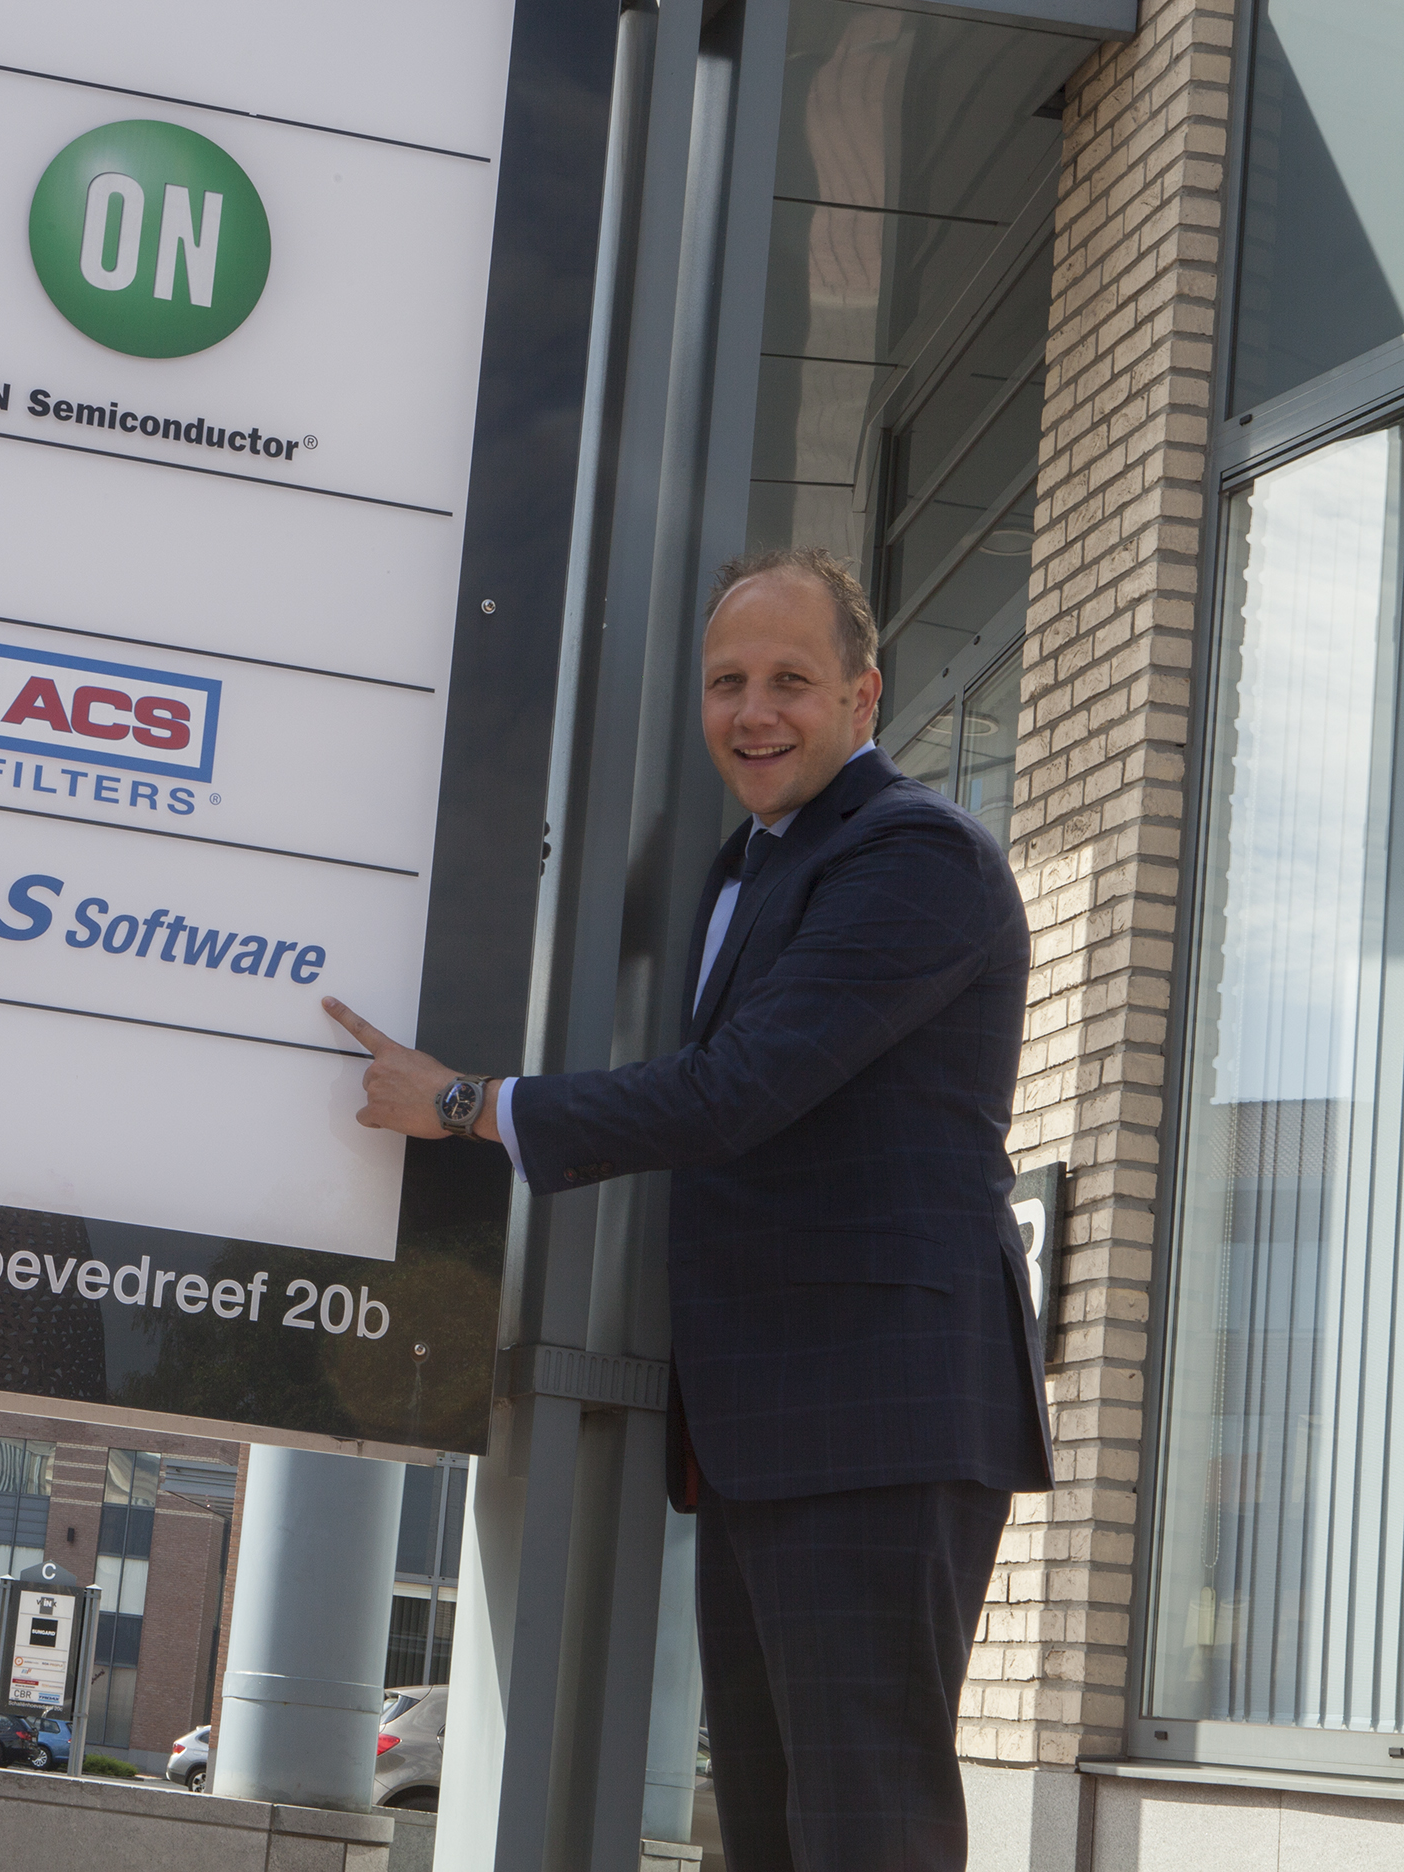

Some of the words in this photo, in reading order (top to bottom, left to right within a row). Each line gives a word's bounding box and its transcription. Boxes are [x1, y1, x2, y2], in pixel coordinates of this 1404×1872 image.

[79, 171, 224, 308] ON
[0, 676, 192, 751] ACS
[65, 896, 327, 985] Software
[281, 1279, 391, 1340] 20b
[42, 1562, 56, 1580] C
[13, 1690, 31, 1699] CBR
